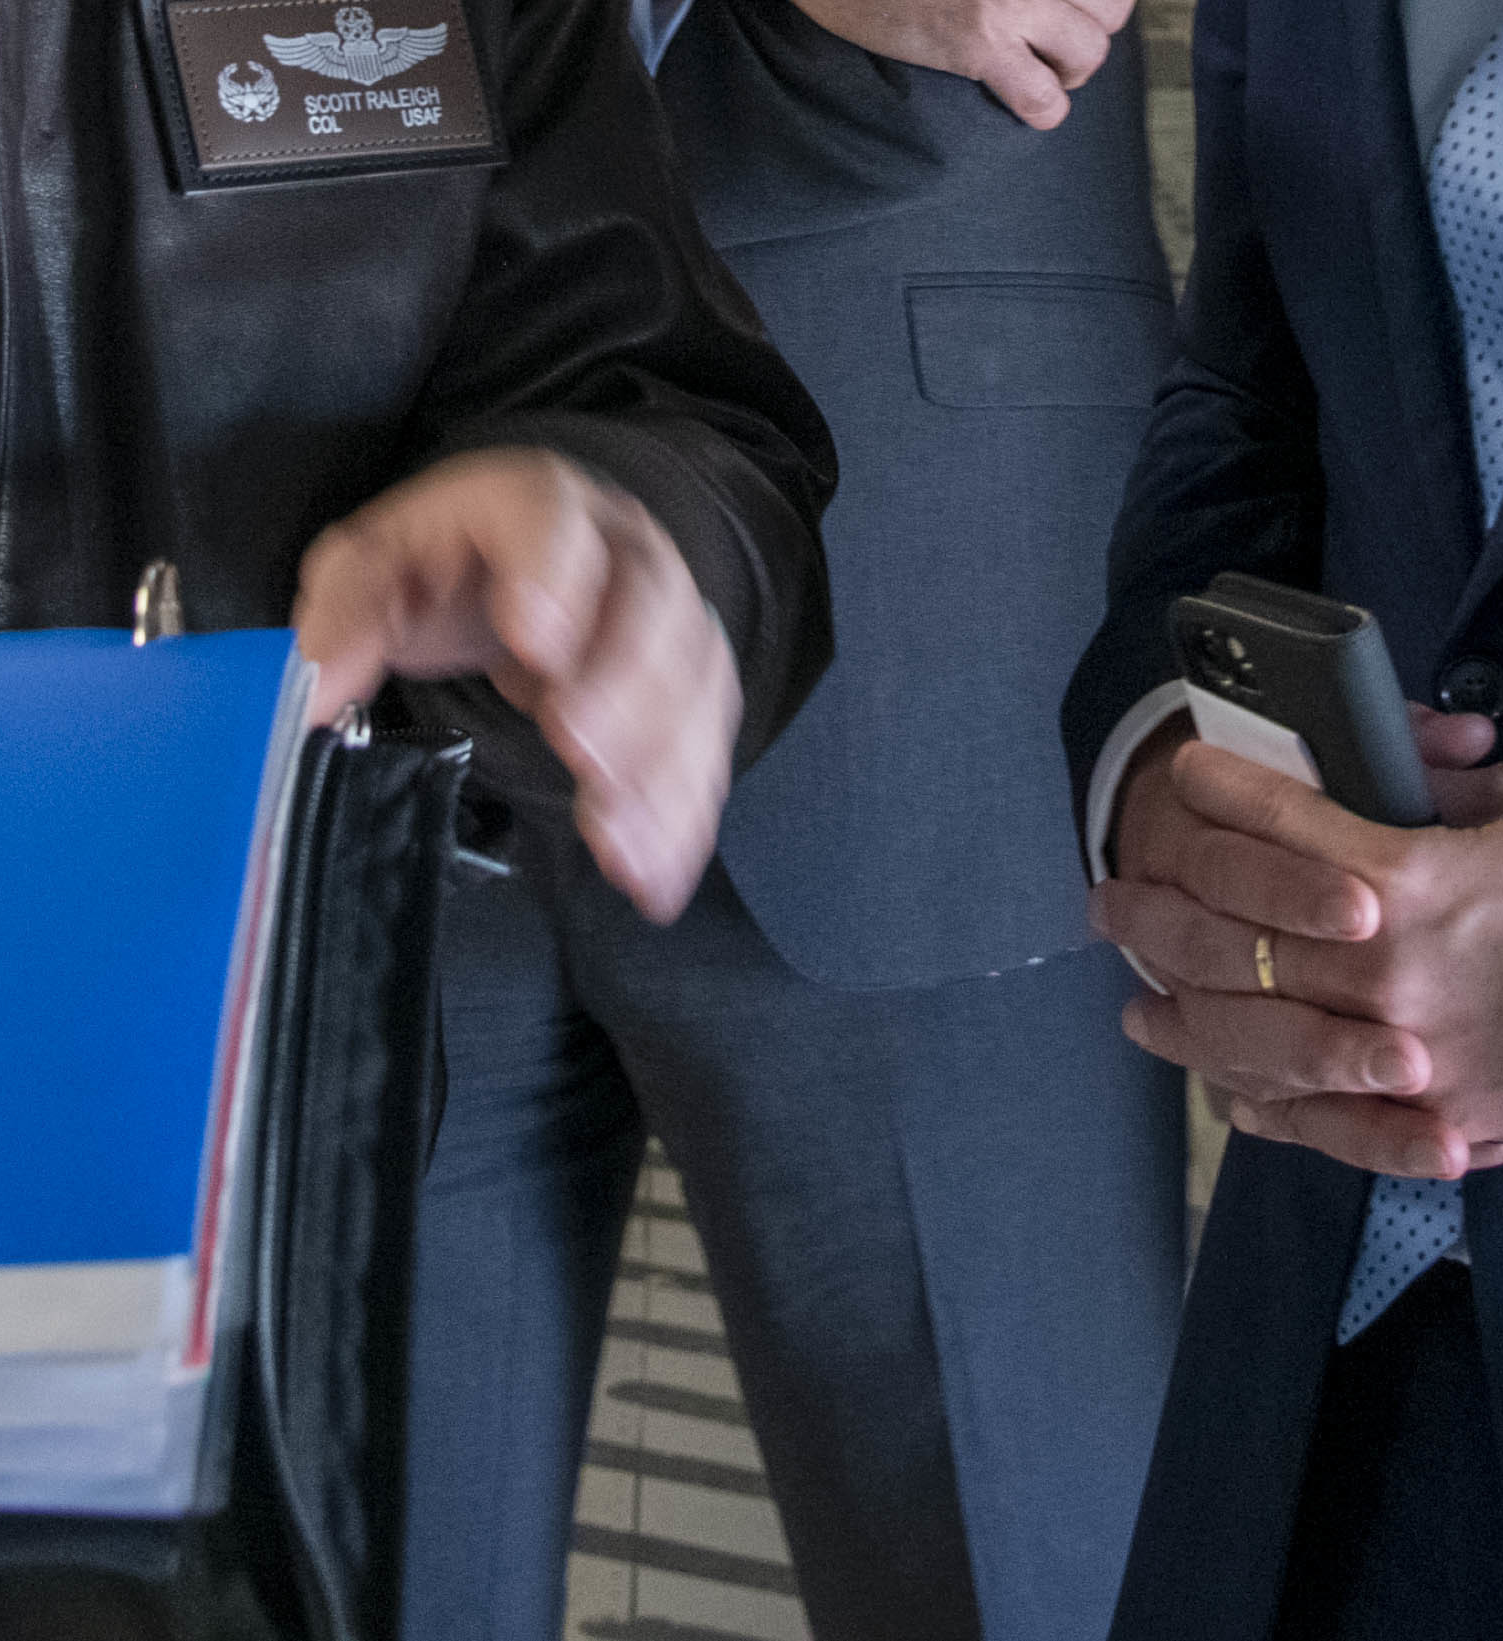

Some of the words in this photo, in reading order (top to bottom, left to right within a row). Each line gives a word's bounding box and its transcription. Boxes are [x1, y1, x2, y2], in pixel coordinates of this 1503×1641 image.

[305, 92, 361, 114] SCOTT
[367, 87, 440, 109] RALEIGH
[309, 115, 342, 134] COL
[402, 108, 442, 127] USAF
